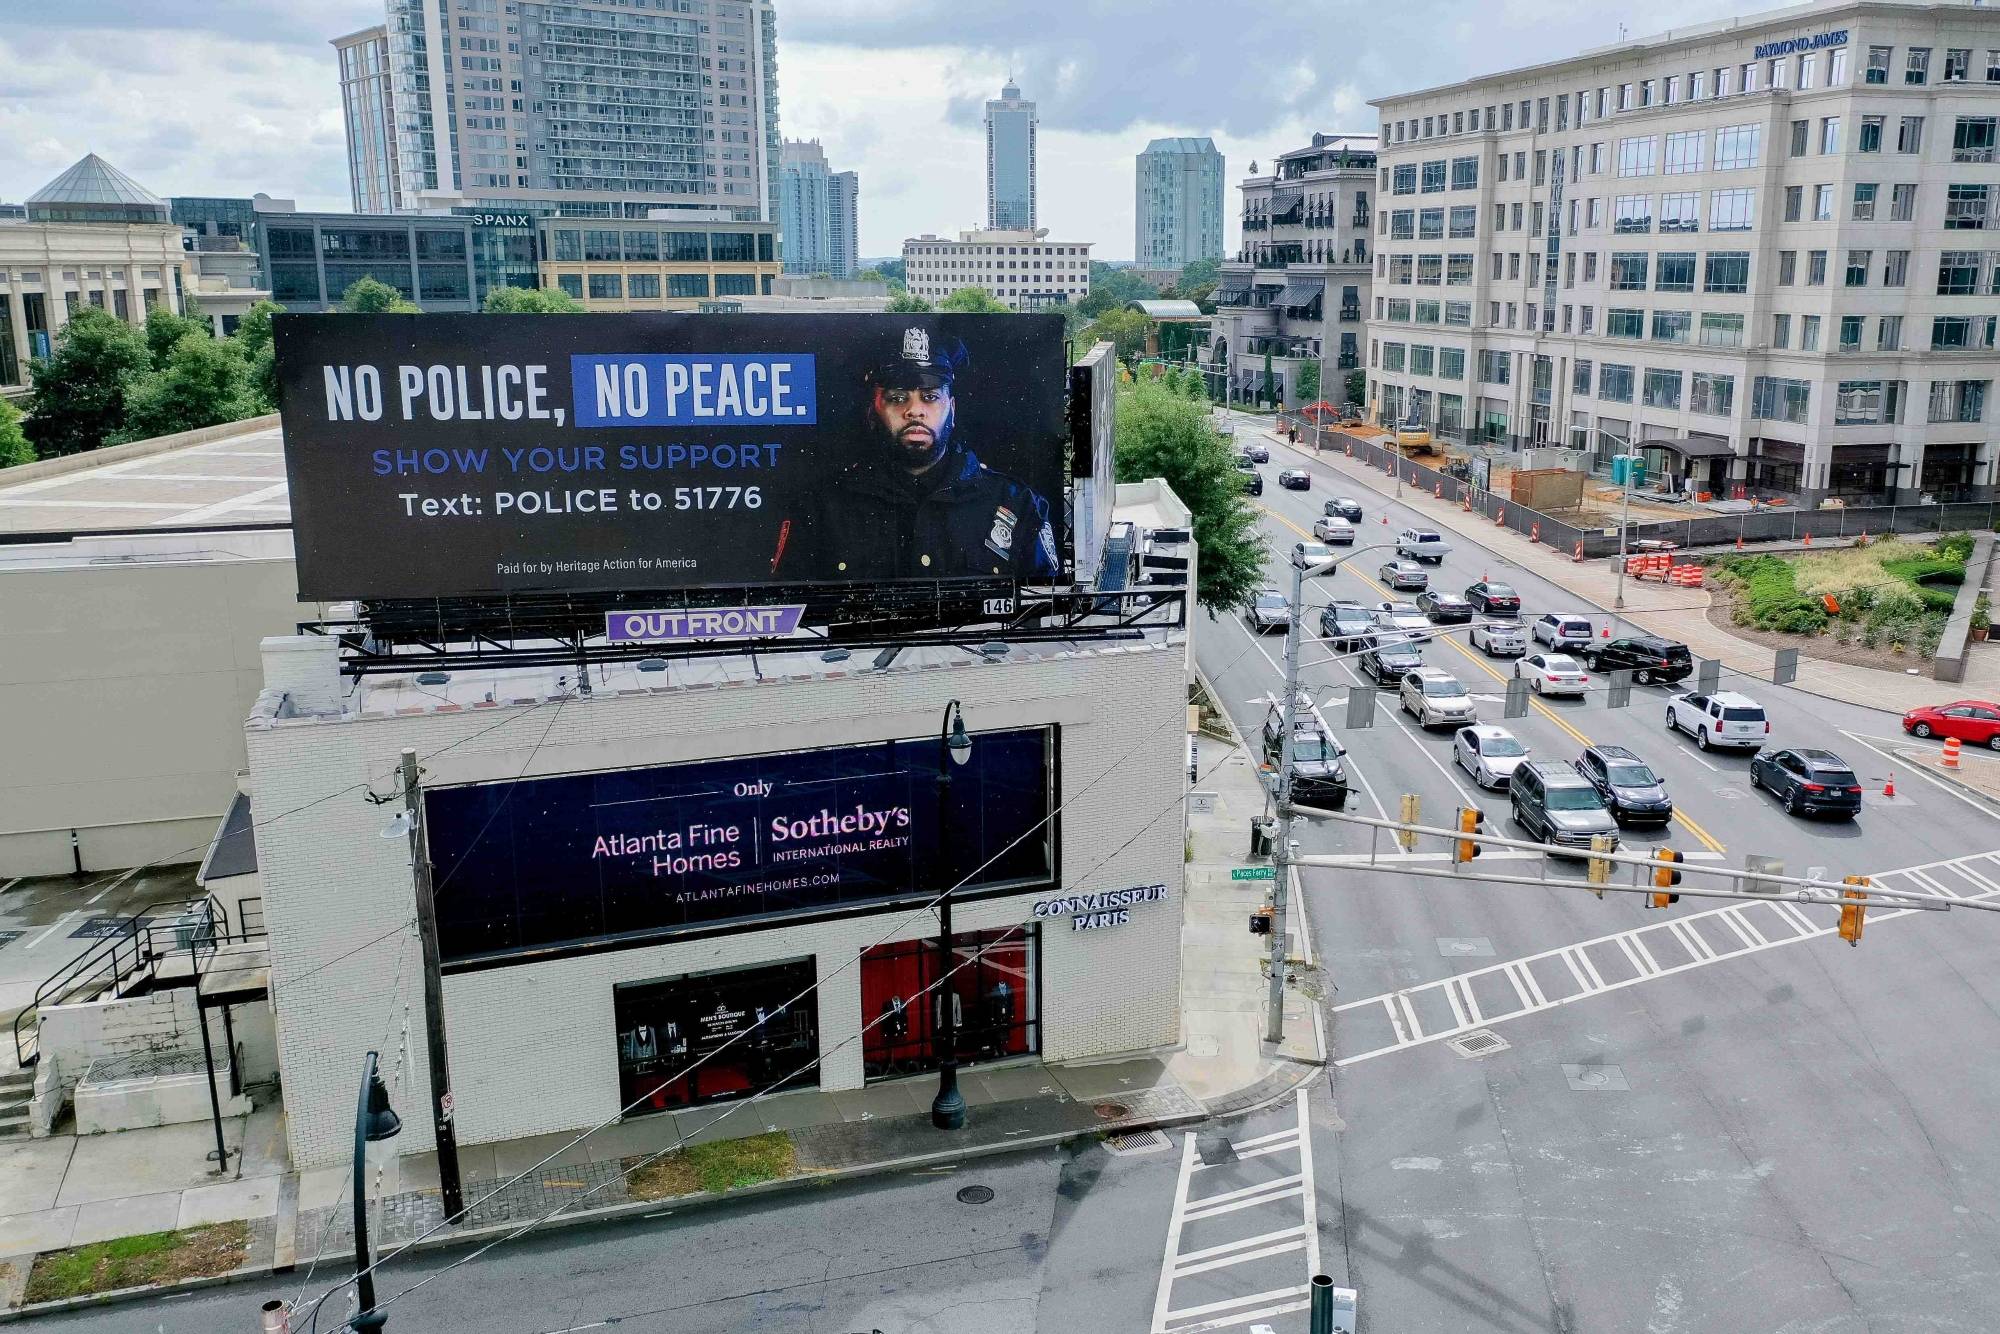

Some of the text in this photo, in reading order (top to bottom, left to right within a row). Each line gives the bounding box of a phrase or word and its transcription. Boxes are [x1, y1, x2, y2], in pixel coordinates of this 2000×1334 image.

[1754, 29, 1848, 59] RAYMOND JAMES
[474, 214, 528, 226] SPANX
[323, 362, 807, 427] NO POLICE, NO PEACE.
[372, 443, 782, 475] SHOW YOUR SUPPORT
[399, 486, 762, 516] Text: POLICE to 51776
[497, 557, 697, 574] Paid for by Heritage Action for America
[985, 599, 1012, 613] 146
[734, 779, 773, 797] Only
[771, 804, 909, 842] Sotheby's
[592, 823, 740, 858] Atlanta Fine
[773, 836, 909, 862] INTERNATIONAL REALTY
[653, 850, 741, 876] Homes
[675, 873, 840, 903] ATLANTAFINEHOMES.COM
[1034, 886, 1169, 918] CONNAISSEUR
[1073, 909, 1130, 931] PARIS
